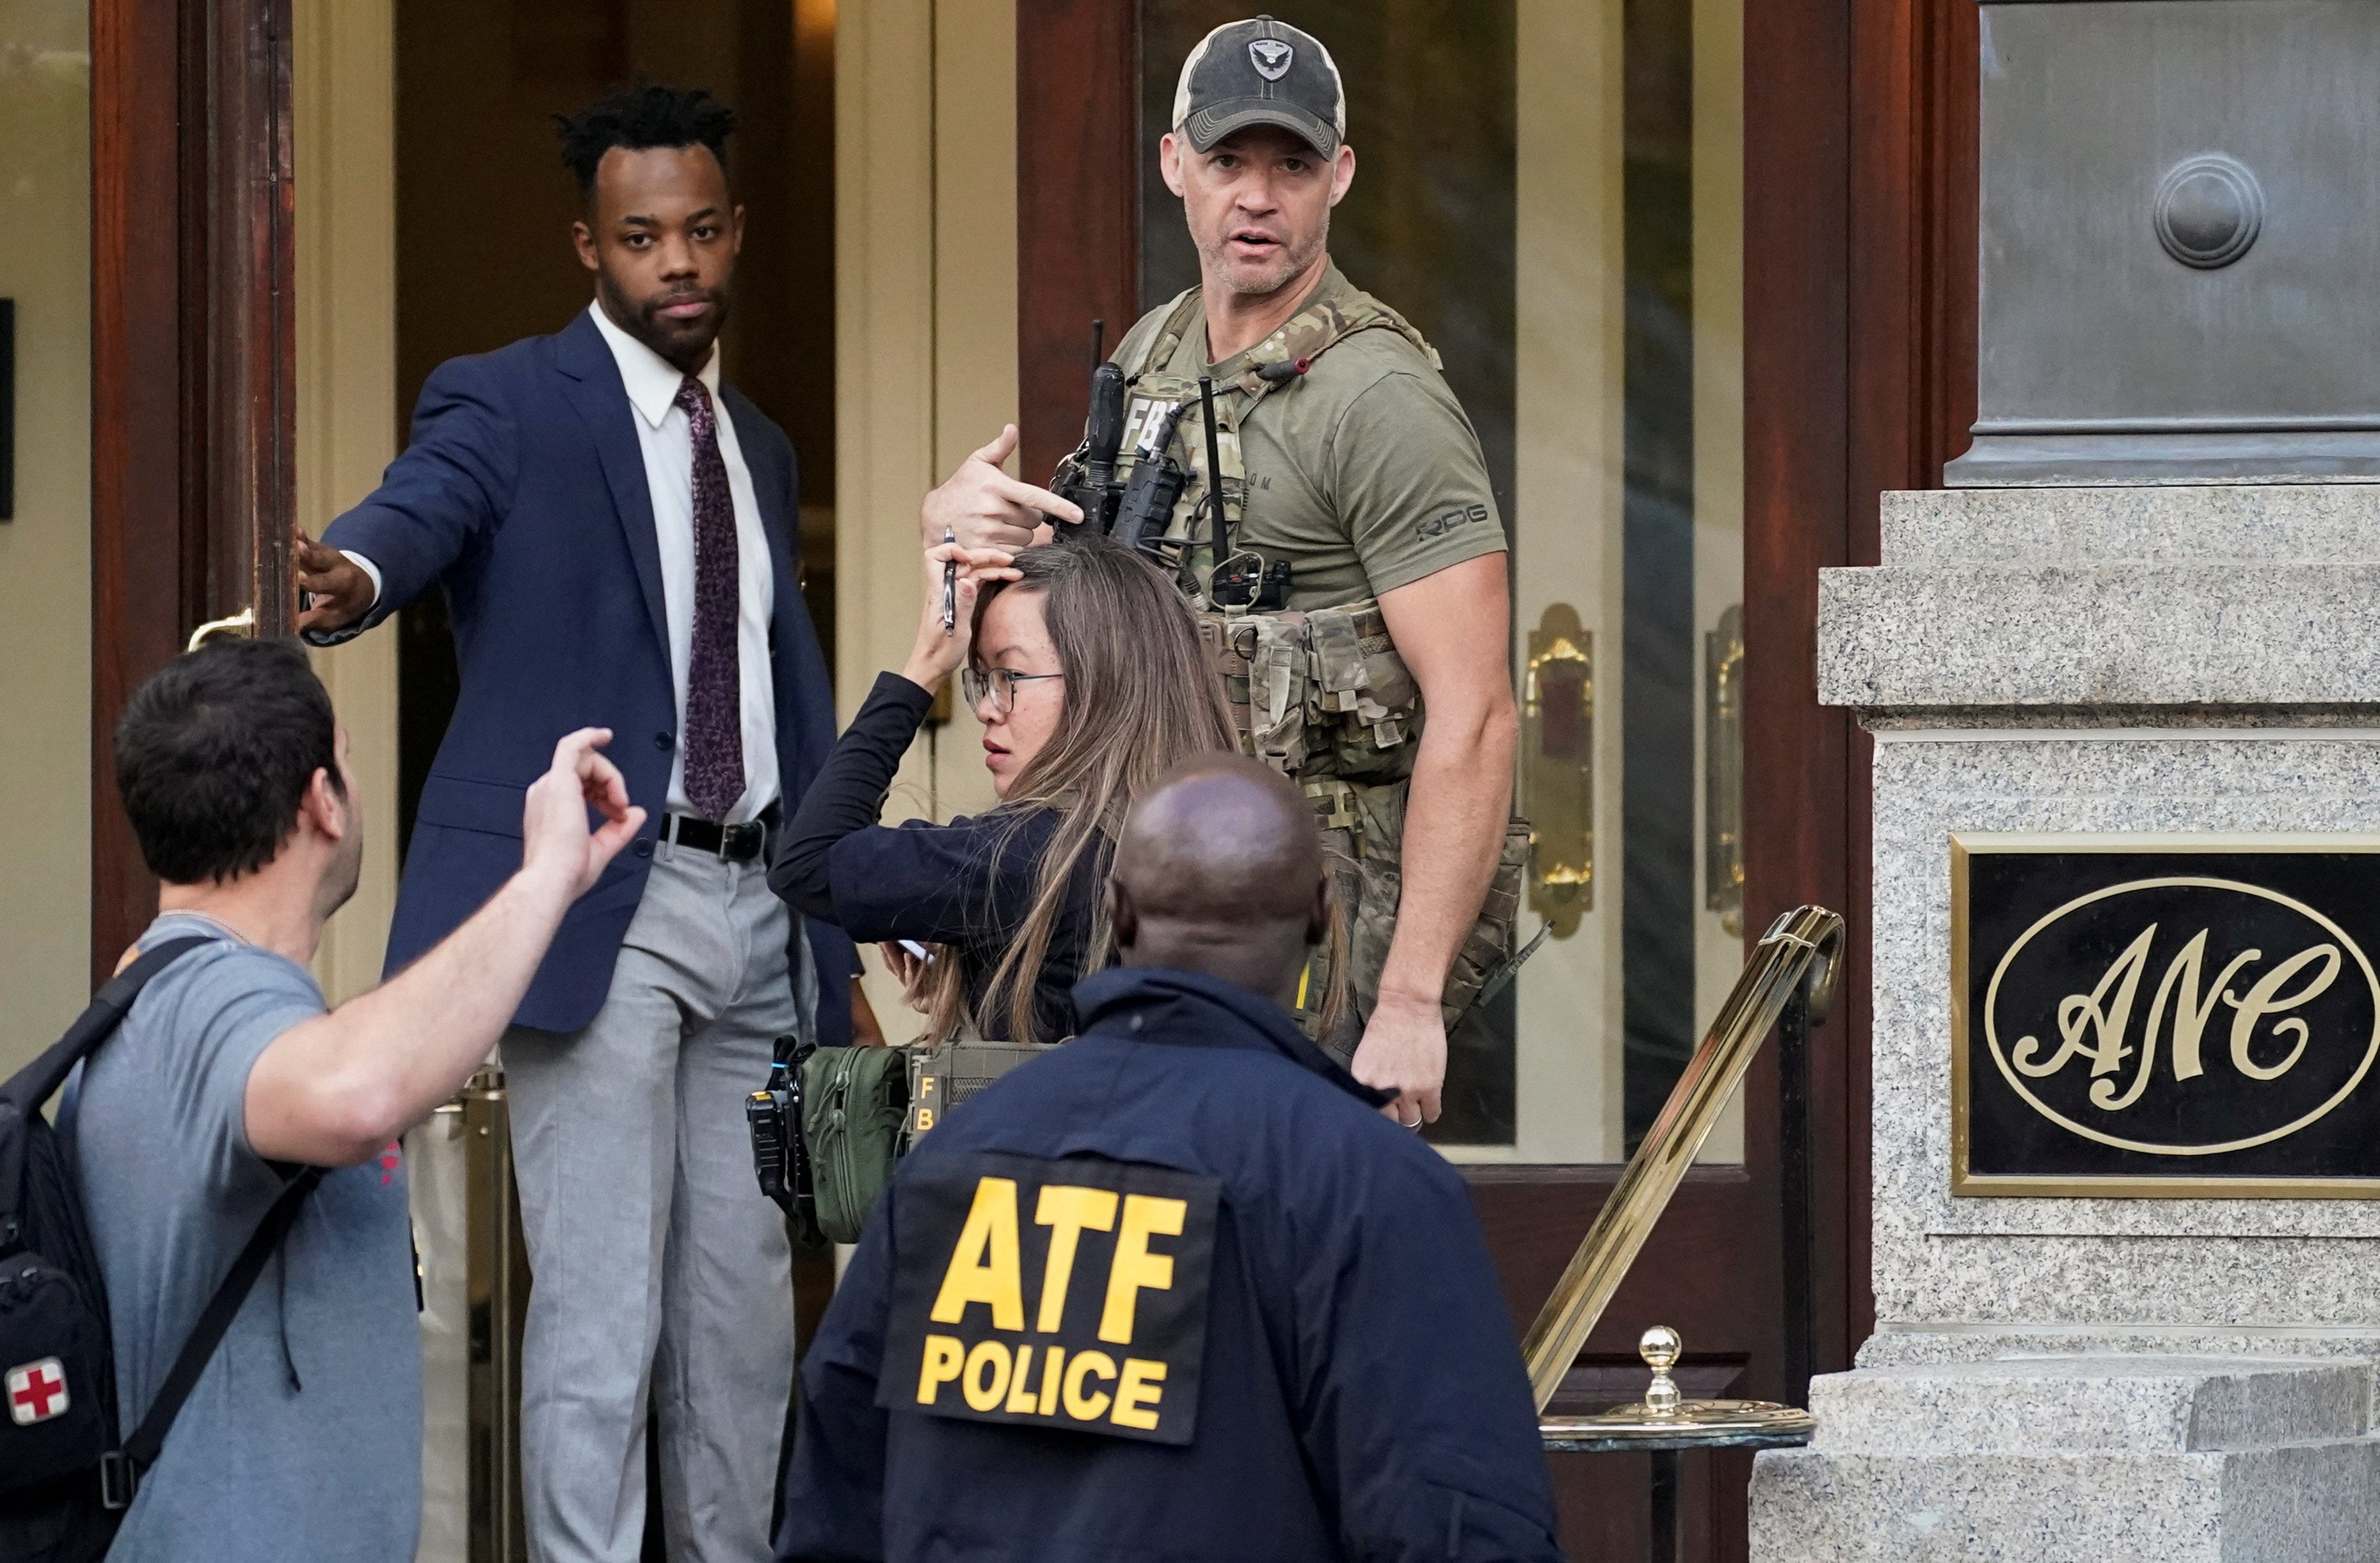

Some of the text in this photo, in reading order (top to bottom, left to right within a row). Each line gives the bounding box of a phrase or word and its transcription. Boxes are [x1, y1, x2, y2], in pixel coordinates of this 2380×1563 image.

[1121, 398, 1179, 451] FB
[2013, 923, 2341, 1110] ANC
[930, 1177, 1188, 1345] ATF
[916, 1334, 1167, 1430] POLICE
